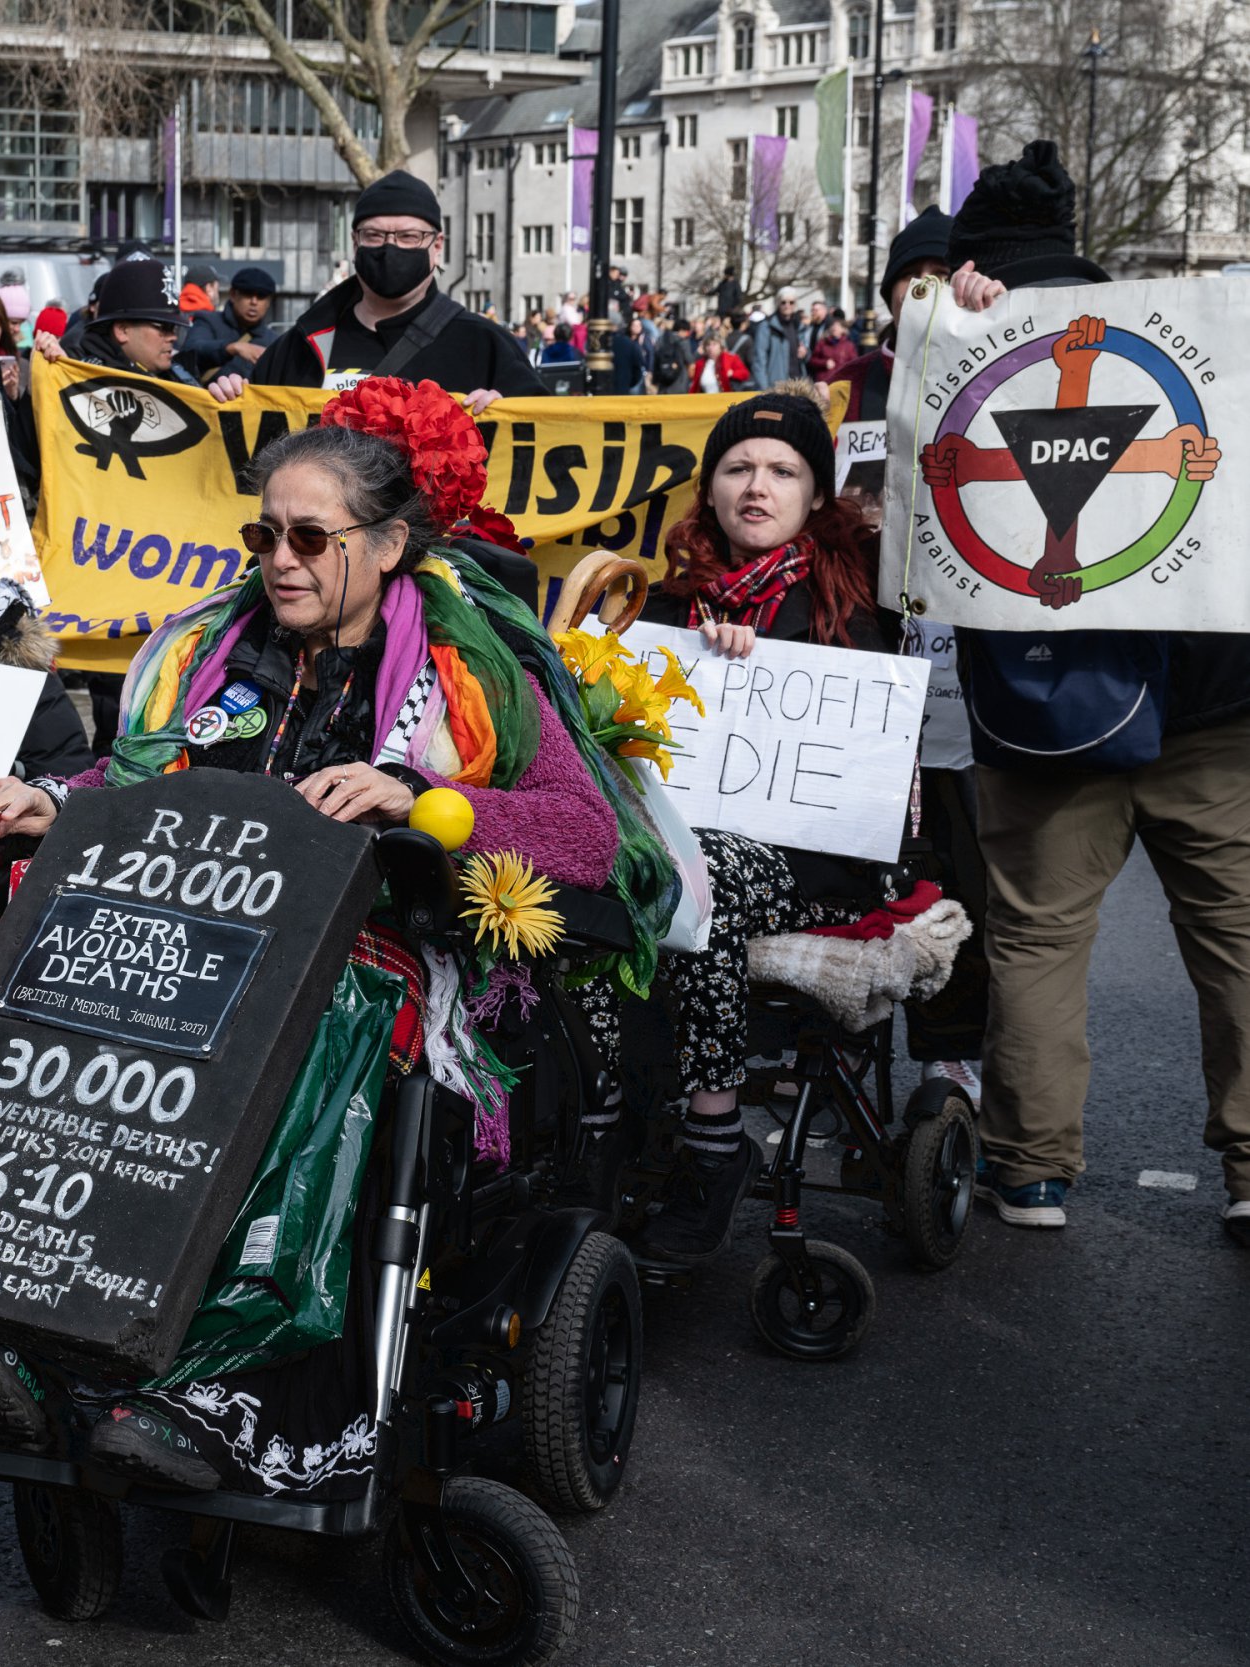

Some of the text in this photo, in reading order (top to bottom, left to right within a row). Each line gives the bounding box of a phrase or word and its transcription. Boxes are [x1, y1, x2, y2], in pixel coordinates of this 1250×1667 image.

[924, 316, 1035, 410] Disabled
[1145, 312, 1216, 385] People
[1031, 437, 1111, 464] DPAC
[914, 512, 983, 598] Against
[1151, 536, 1202, 584] Cuts
[720, 663, 911, 743] PROFIT,
[719, 733, 844, 810] DIE
[142, 808, 269, 860] R.I.P.
[66, 844, 283, 917] 120,000
[89, 908, 188, 946] EXTRA
[37, 925, 224, 982] AVOIDABLE
[38, 954, 181, 1002] DEATHS
[12, 985, 68, 1009] (BRITISH
[70, 997, 121, 1021] MEDICAL
[179, 1020, 208, 1037] 2017)
[62, 1141, 113, 1173] 2019
[112, 1160, 186, 1191] REPORT
[111, 1125, 221, 1174] DEATHS!
[68, 1263, 163, 1309] PEOPLE!
